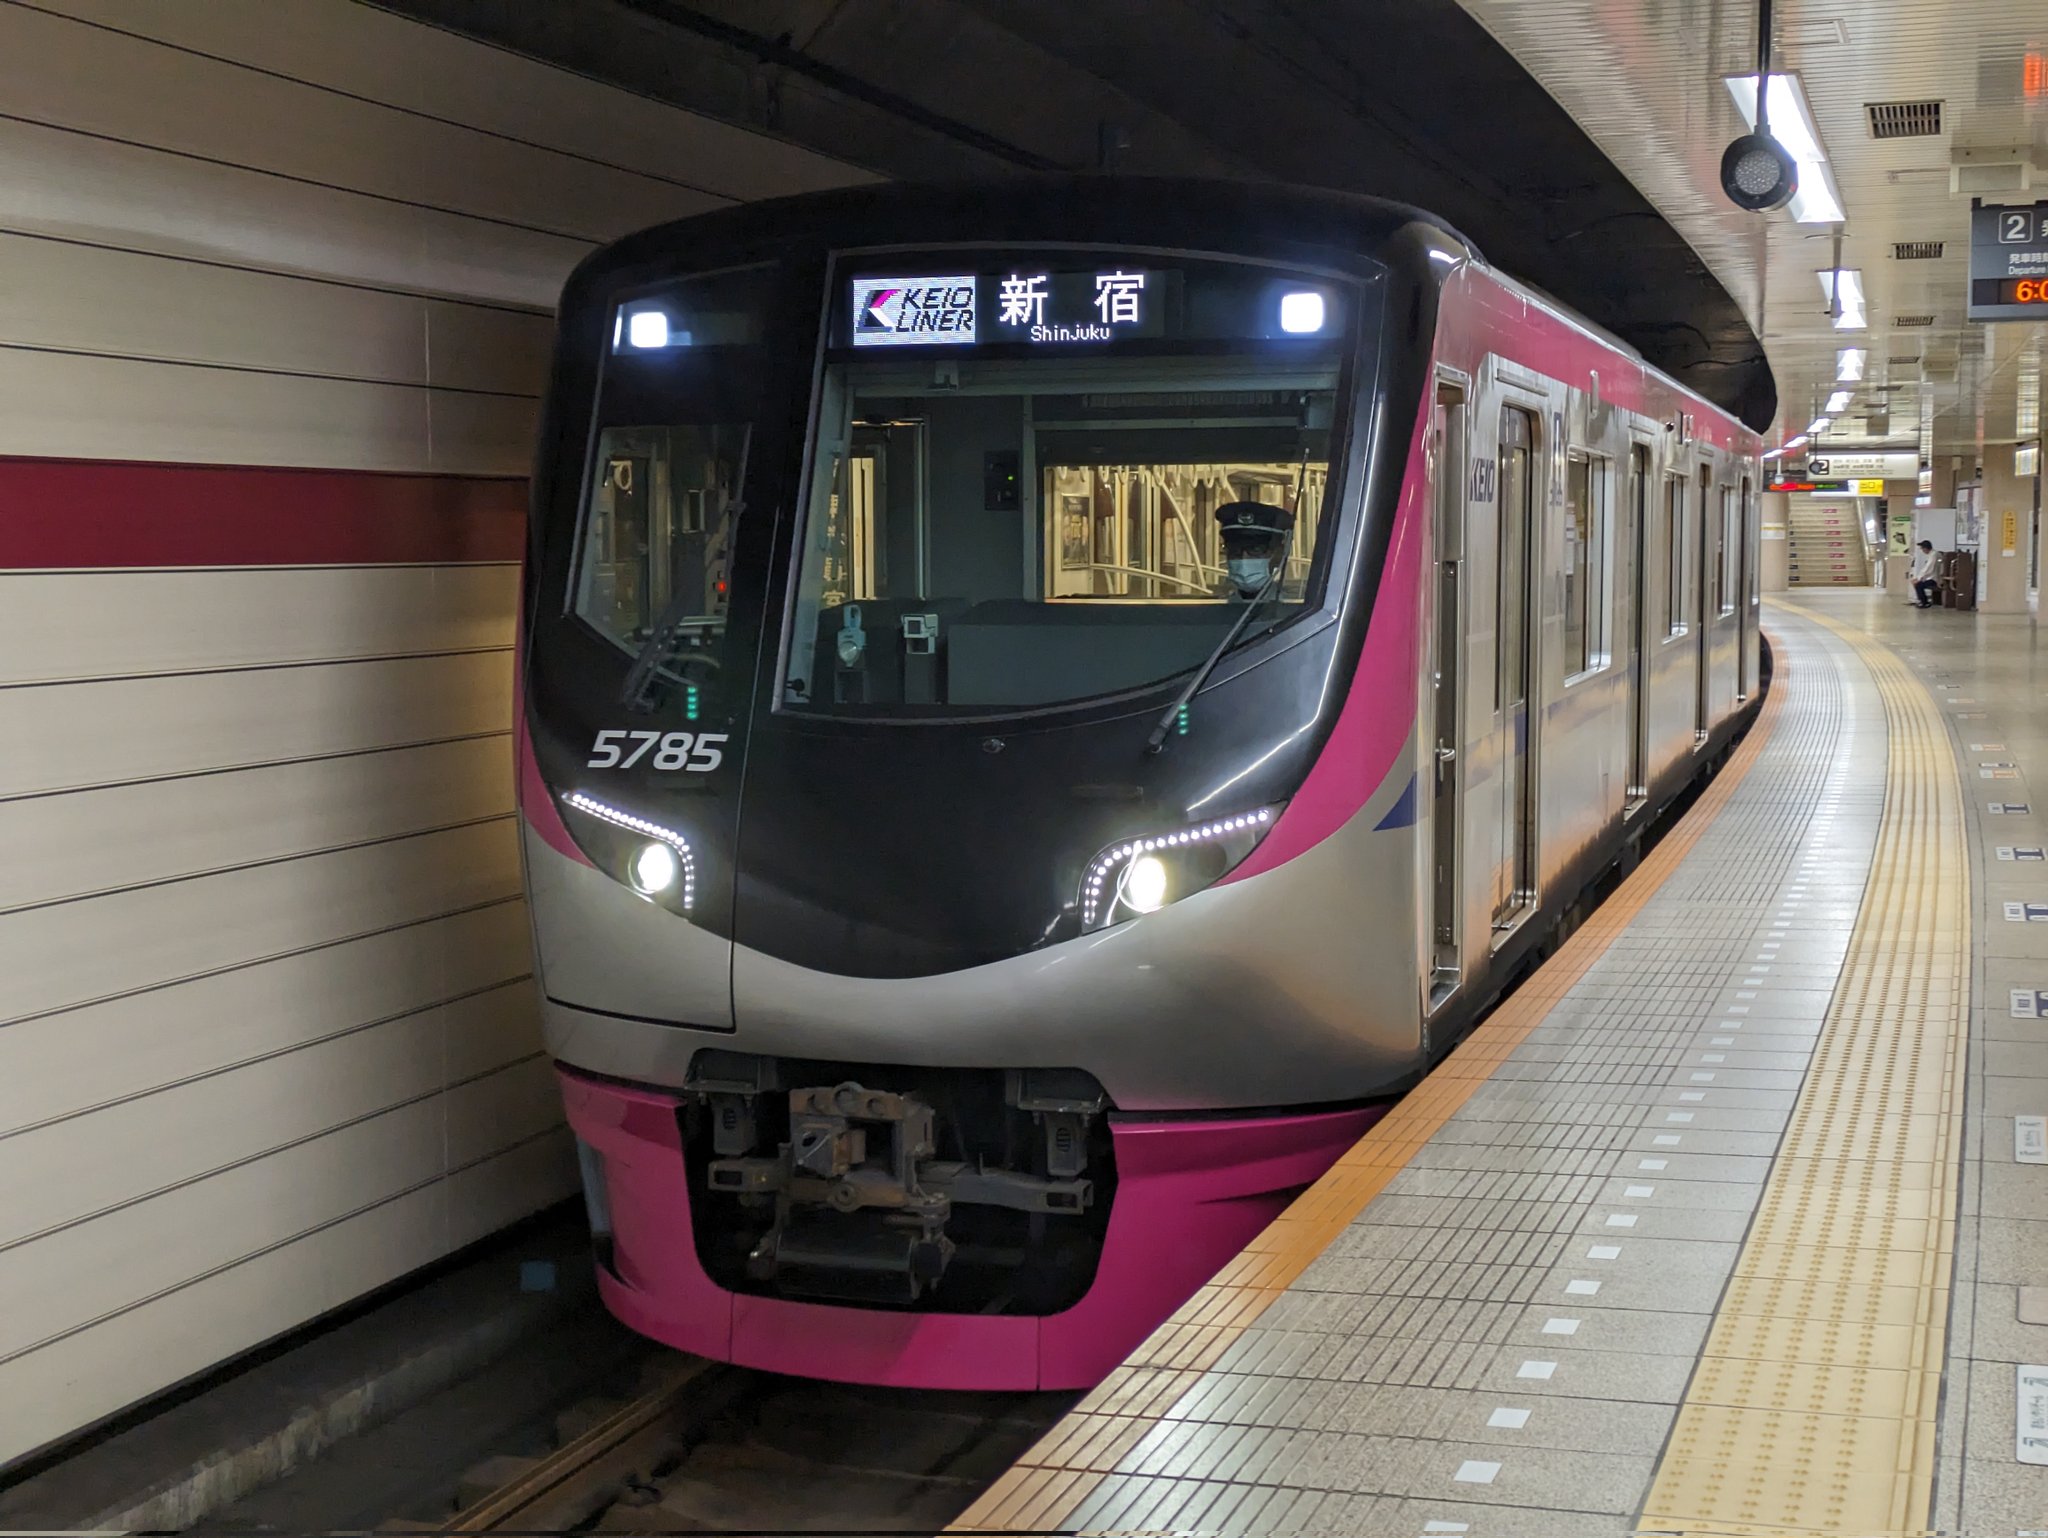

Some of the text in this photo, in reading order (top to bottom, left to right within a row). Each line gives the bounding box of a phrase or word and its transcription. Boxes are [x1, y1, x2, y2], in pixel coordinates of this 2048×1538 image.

[2006, 215, 2025, 239] 2
[2008, 266, 2046, 276] Departure
[900, 287, 974, 309] KEIO
[1000, 271, 1145, 326] 新宿
[895, 309, 974, 332] LINER
[1030, 324, 1111, 343] Shinjuku
[1470, 457, 1495, 503] KEIO
[587, 730, 728, 772] 5785
